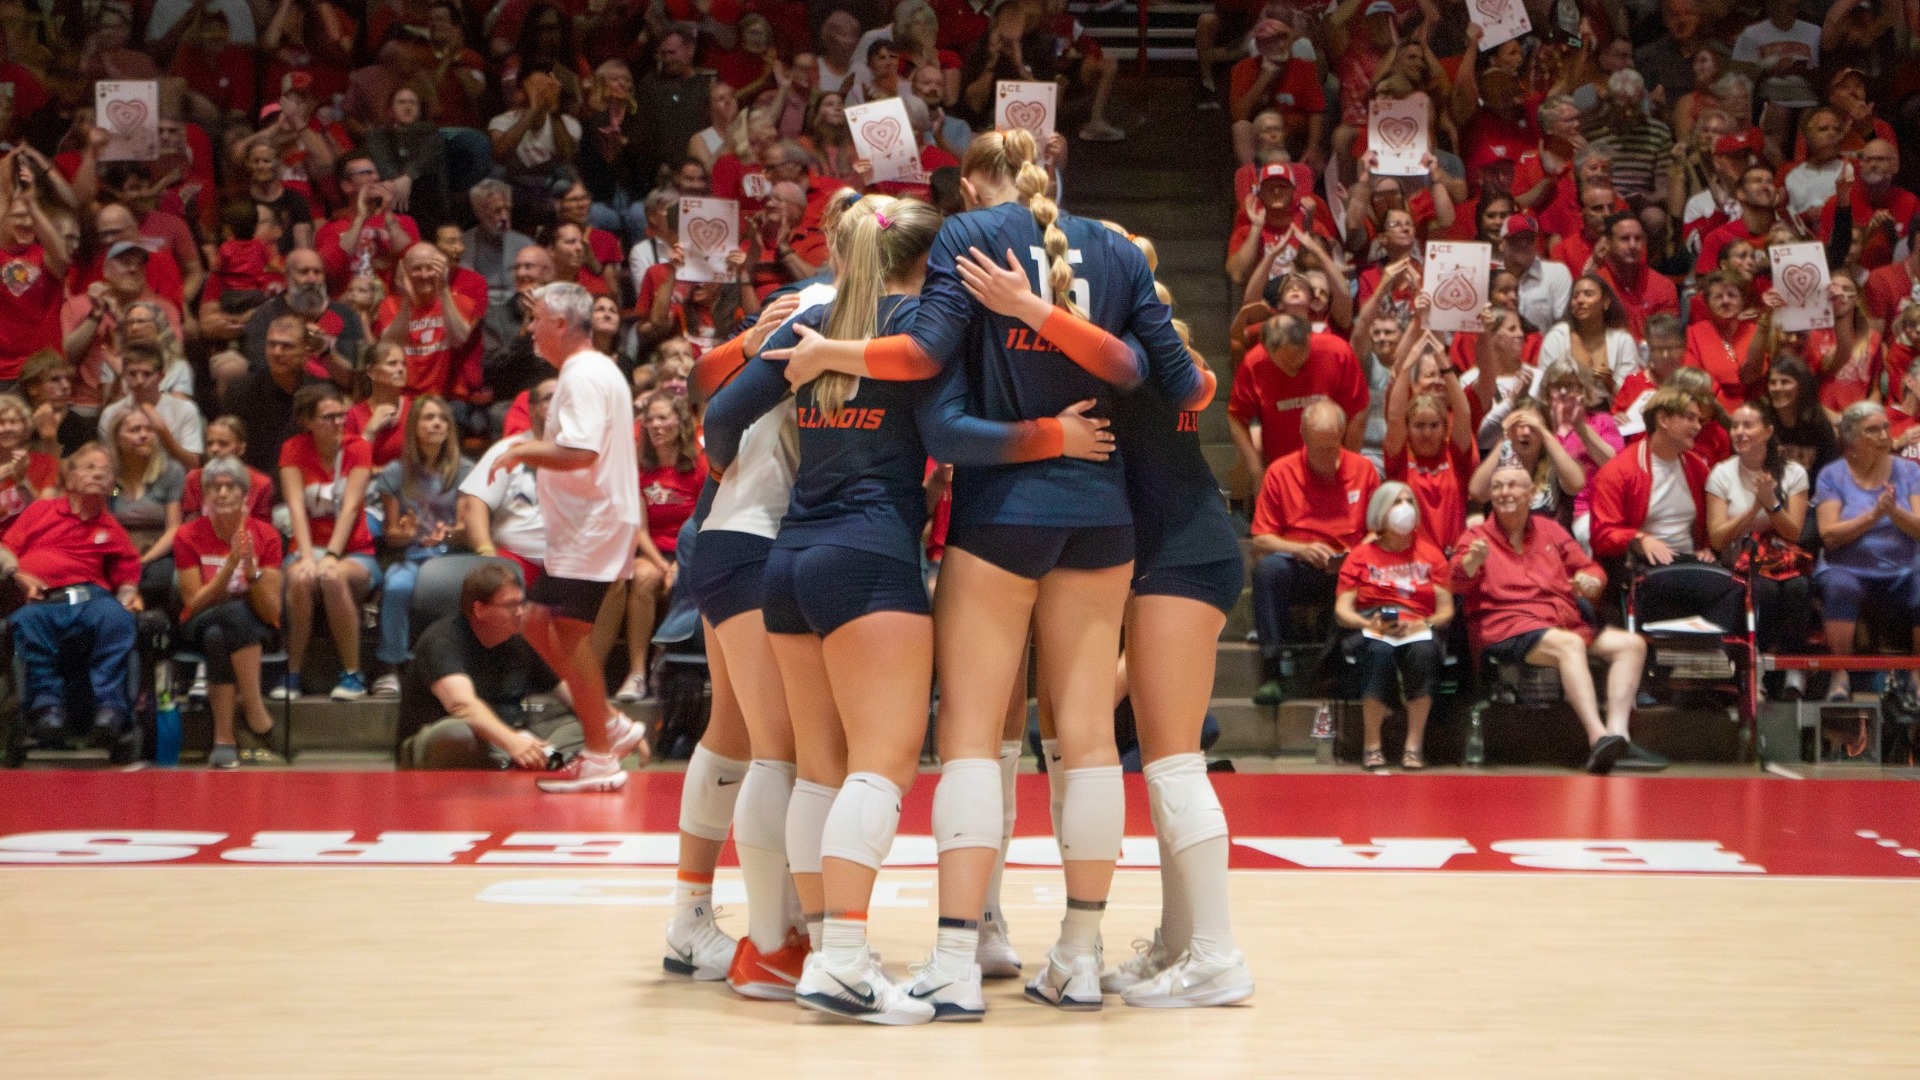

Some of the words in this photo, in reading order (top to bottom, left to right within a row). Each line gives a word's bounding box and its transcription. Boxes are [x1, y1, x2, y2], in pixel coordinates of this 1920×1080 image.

[1000, 84, 1021, 93] ACE
[850, 107, 869, 117] ACE
[1429, 244, 1453, 254] ACE
[1773, 247, 1791, 258] ACE
